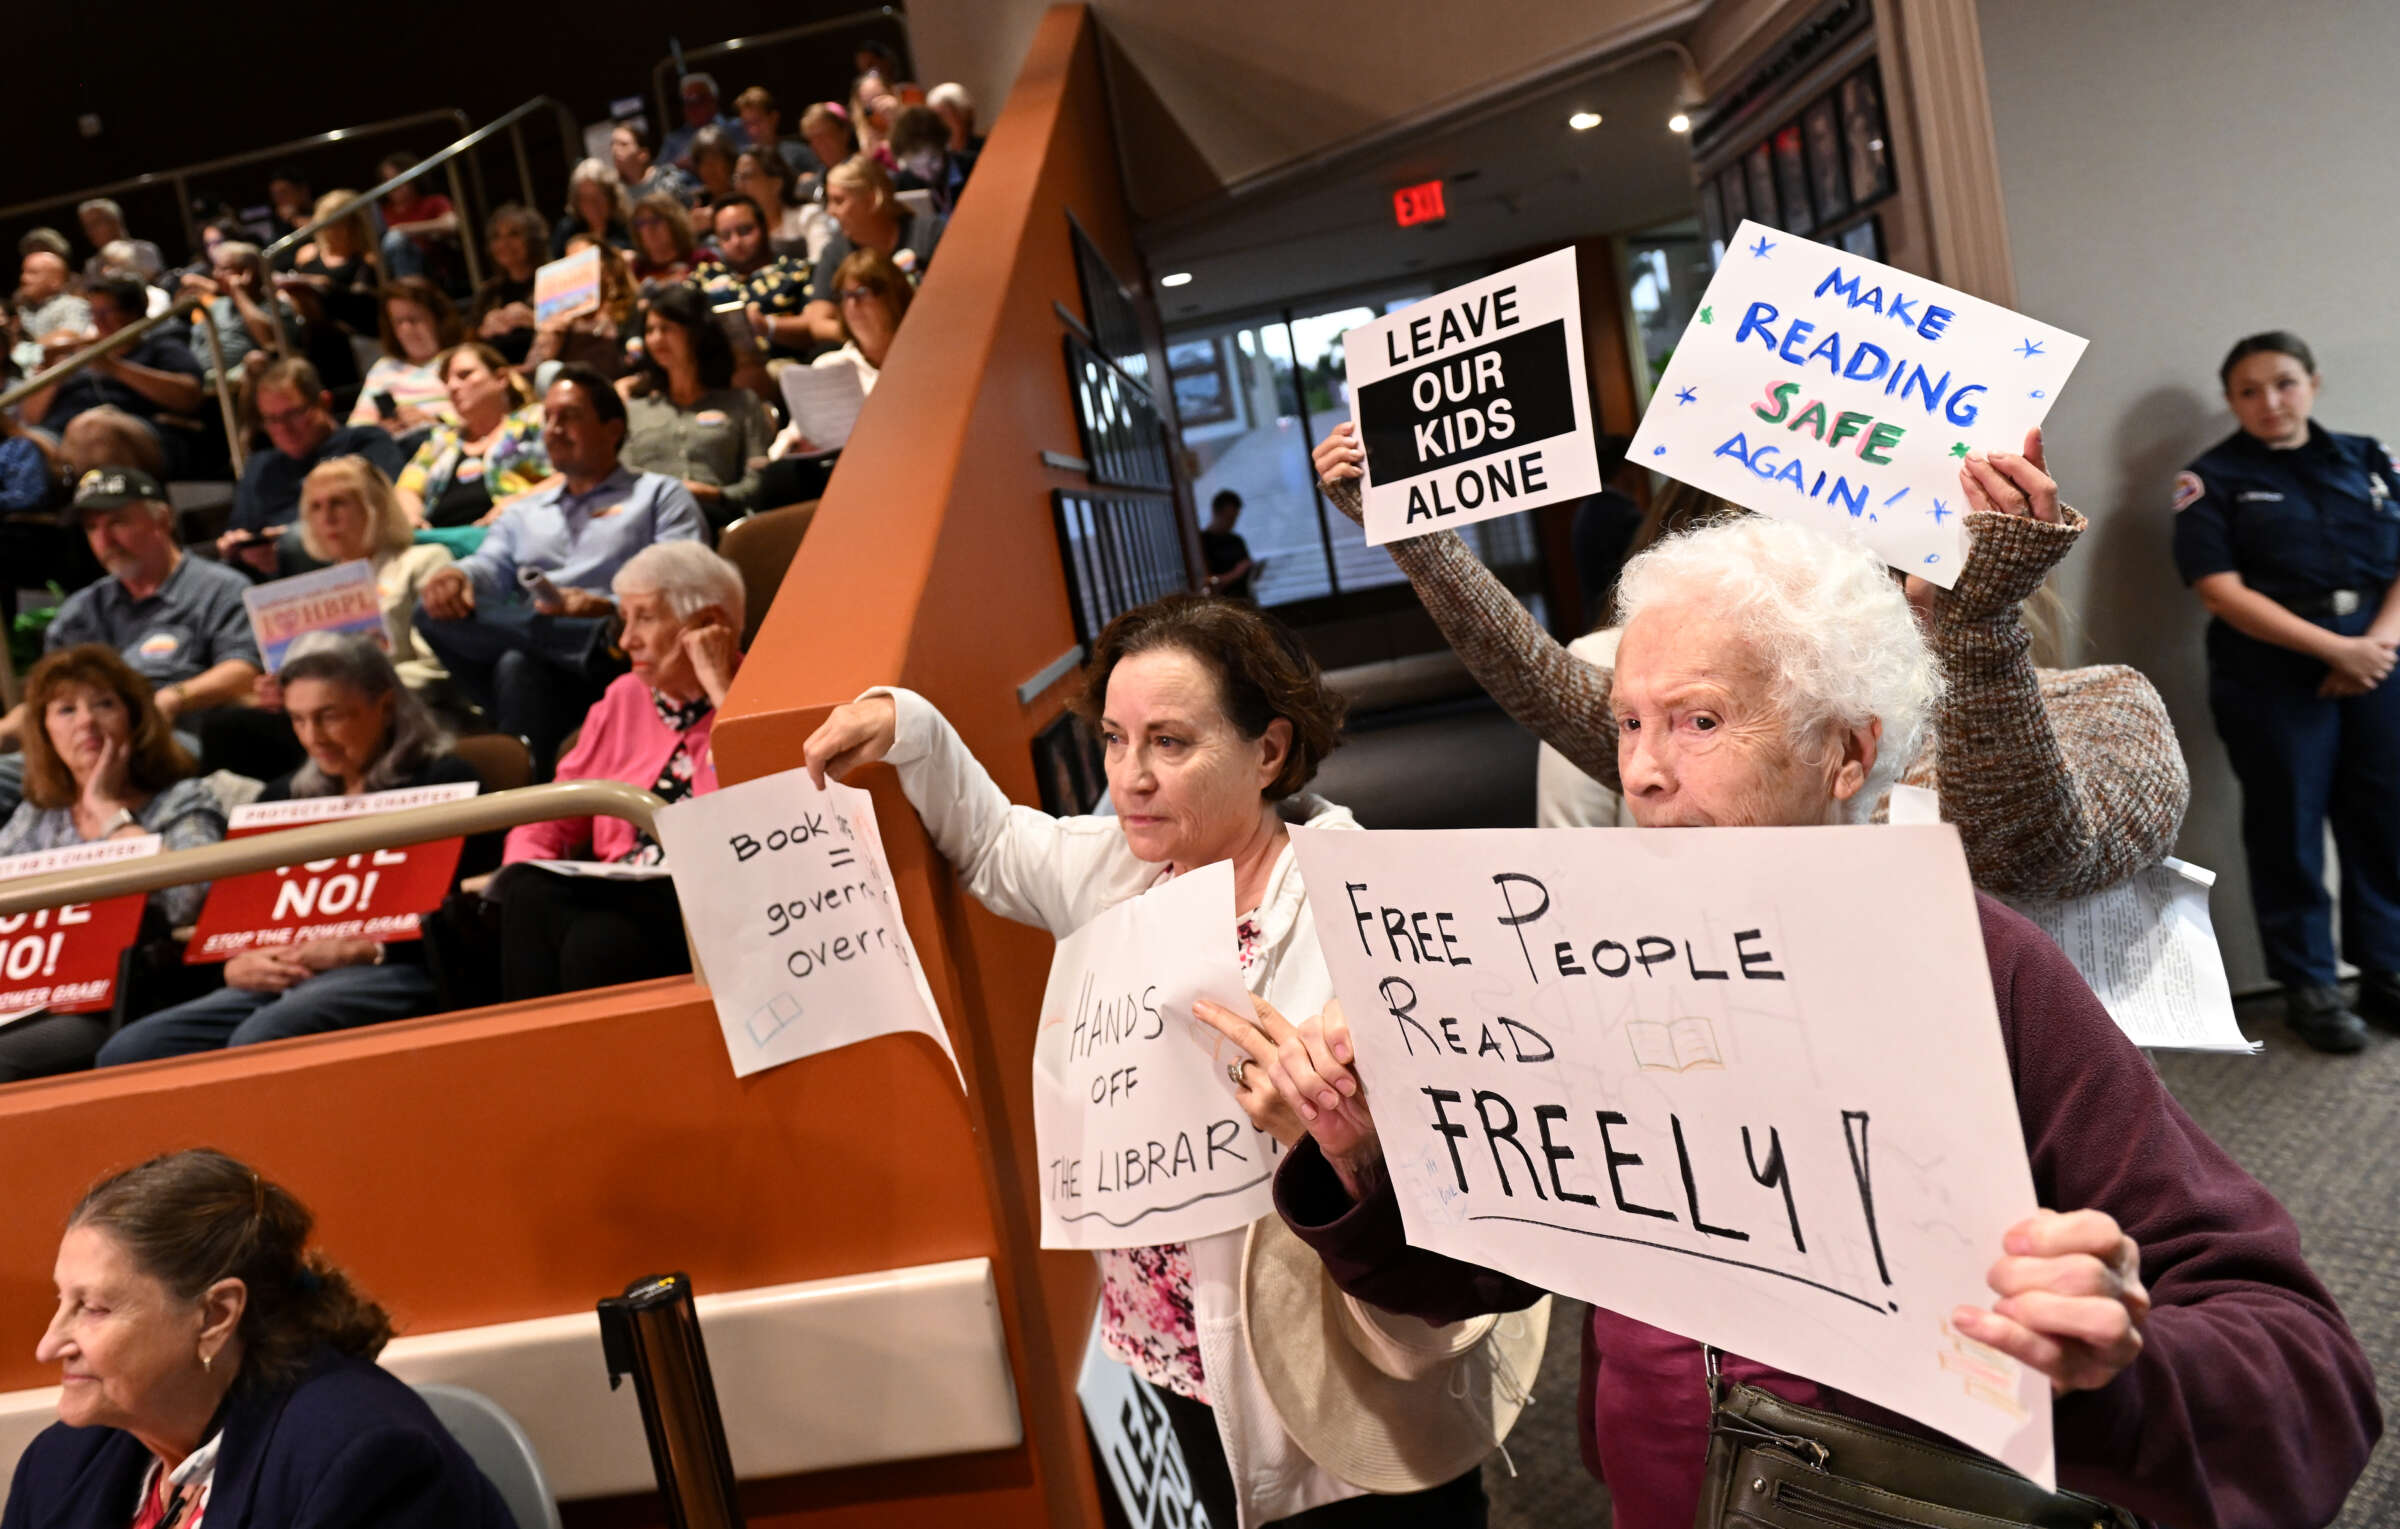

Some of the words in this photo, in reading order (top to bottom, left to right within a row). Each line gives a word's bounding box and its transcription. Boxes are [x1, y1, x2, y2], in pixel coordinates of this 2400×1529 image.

[1394, 181, 1445, 226] EXIT
[1387, 285, 1520, 367] LEAVE
[1814, 267, 1956, 341] MAKE
[1412, 351, 1505, 412] OUR
[1736, 302, 1988, 427] READING
[1414, 398, 1516, 462] KIDS
[1750, 380, 1907, 465] SAFE
[1407, 451, 1547, 525] ALONE
[1714, 432, 1911, 522] AGAIN!
[729, 812, 830, 862] Book
[271, 870, 380, 921] NO!
[767, 880, 889, 936] govern
[203, 930, 255, 951] STOP
[256, 928, 293, 945] THE
[294, 919, 364, 942] POWER
[787, 928, 911, 977] overr
[1070, 970, 1164, 1062] HANDS
[1091, 1066, 1138, 1107] OFF
[1050, 1155, 1081, 1200] THE
[1114, 1371, 1164, 1522] LEA
